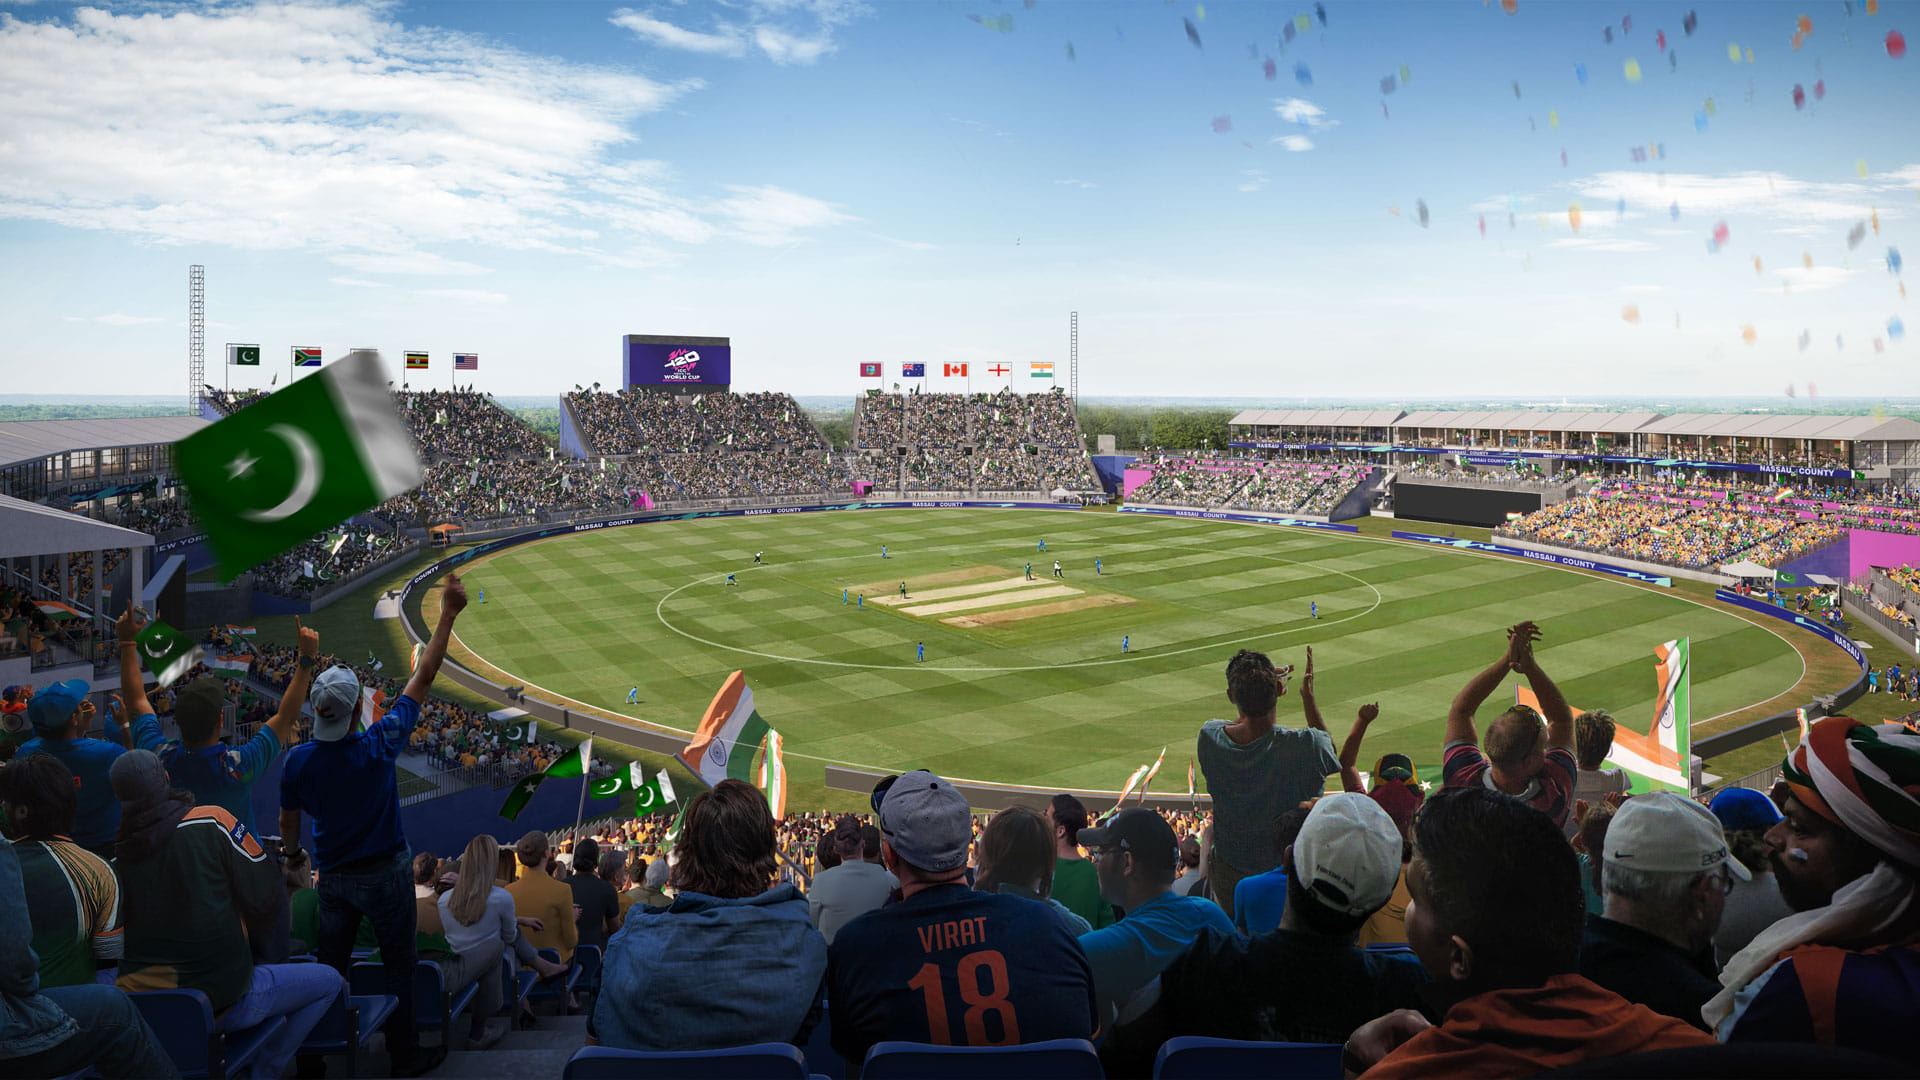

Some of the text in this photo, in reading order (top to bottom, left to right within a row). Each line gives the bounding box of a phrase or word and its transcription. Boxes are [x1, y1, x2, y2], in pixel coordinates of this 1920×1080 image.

[1760, 465, 1835, 477] NASSAU COUNTY
[575, 519, 634, 531] NASSAU COUNTY
[1523, 550, 1596, 569] NASSAU COUNTY
[414, 565, 440, 584] COUNTY
[1834, 633, 1860, 661] NASSAU
[917, 916, 987, 953] VIRAT
[907, 949, 1020, 1047] 18
